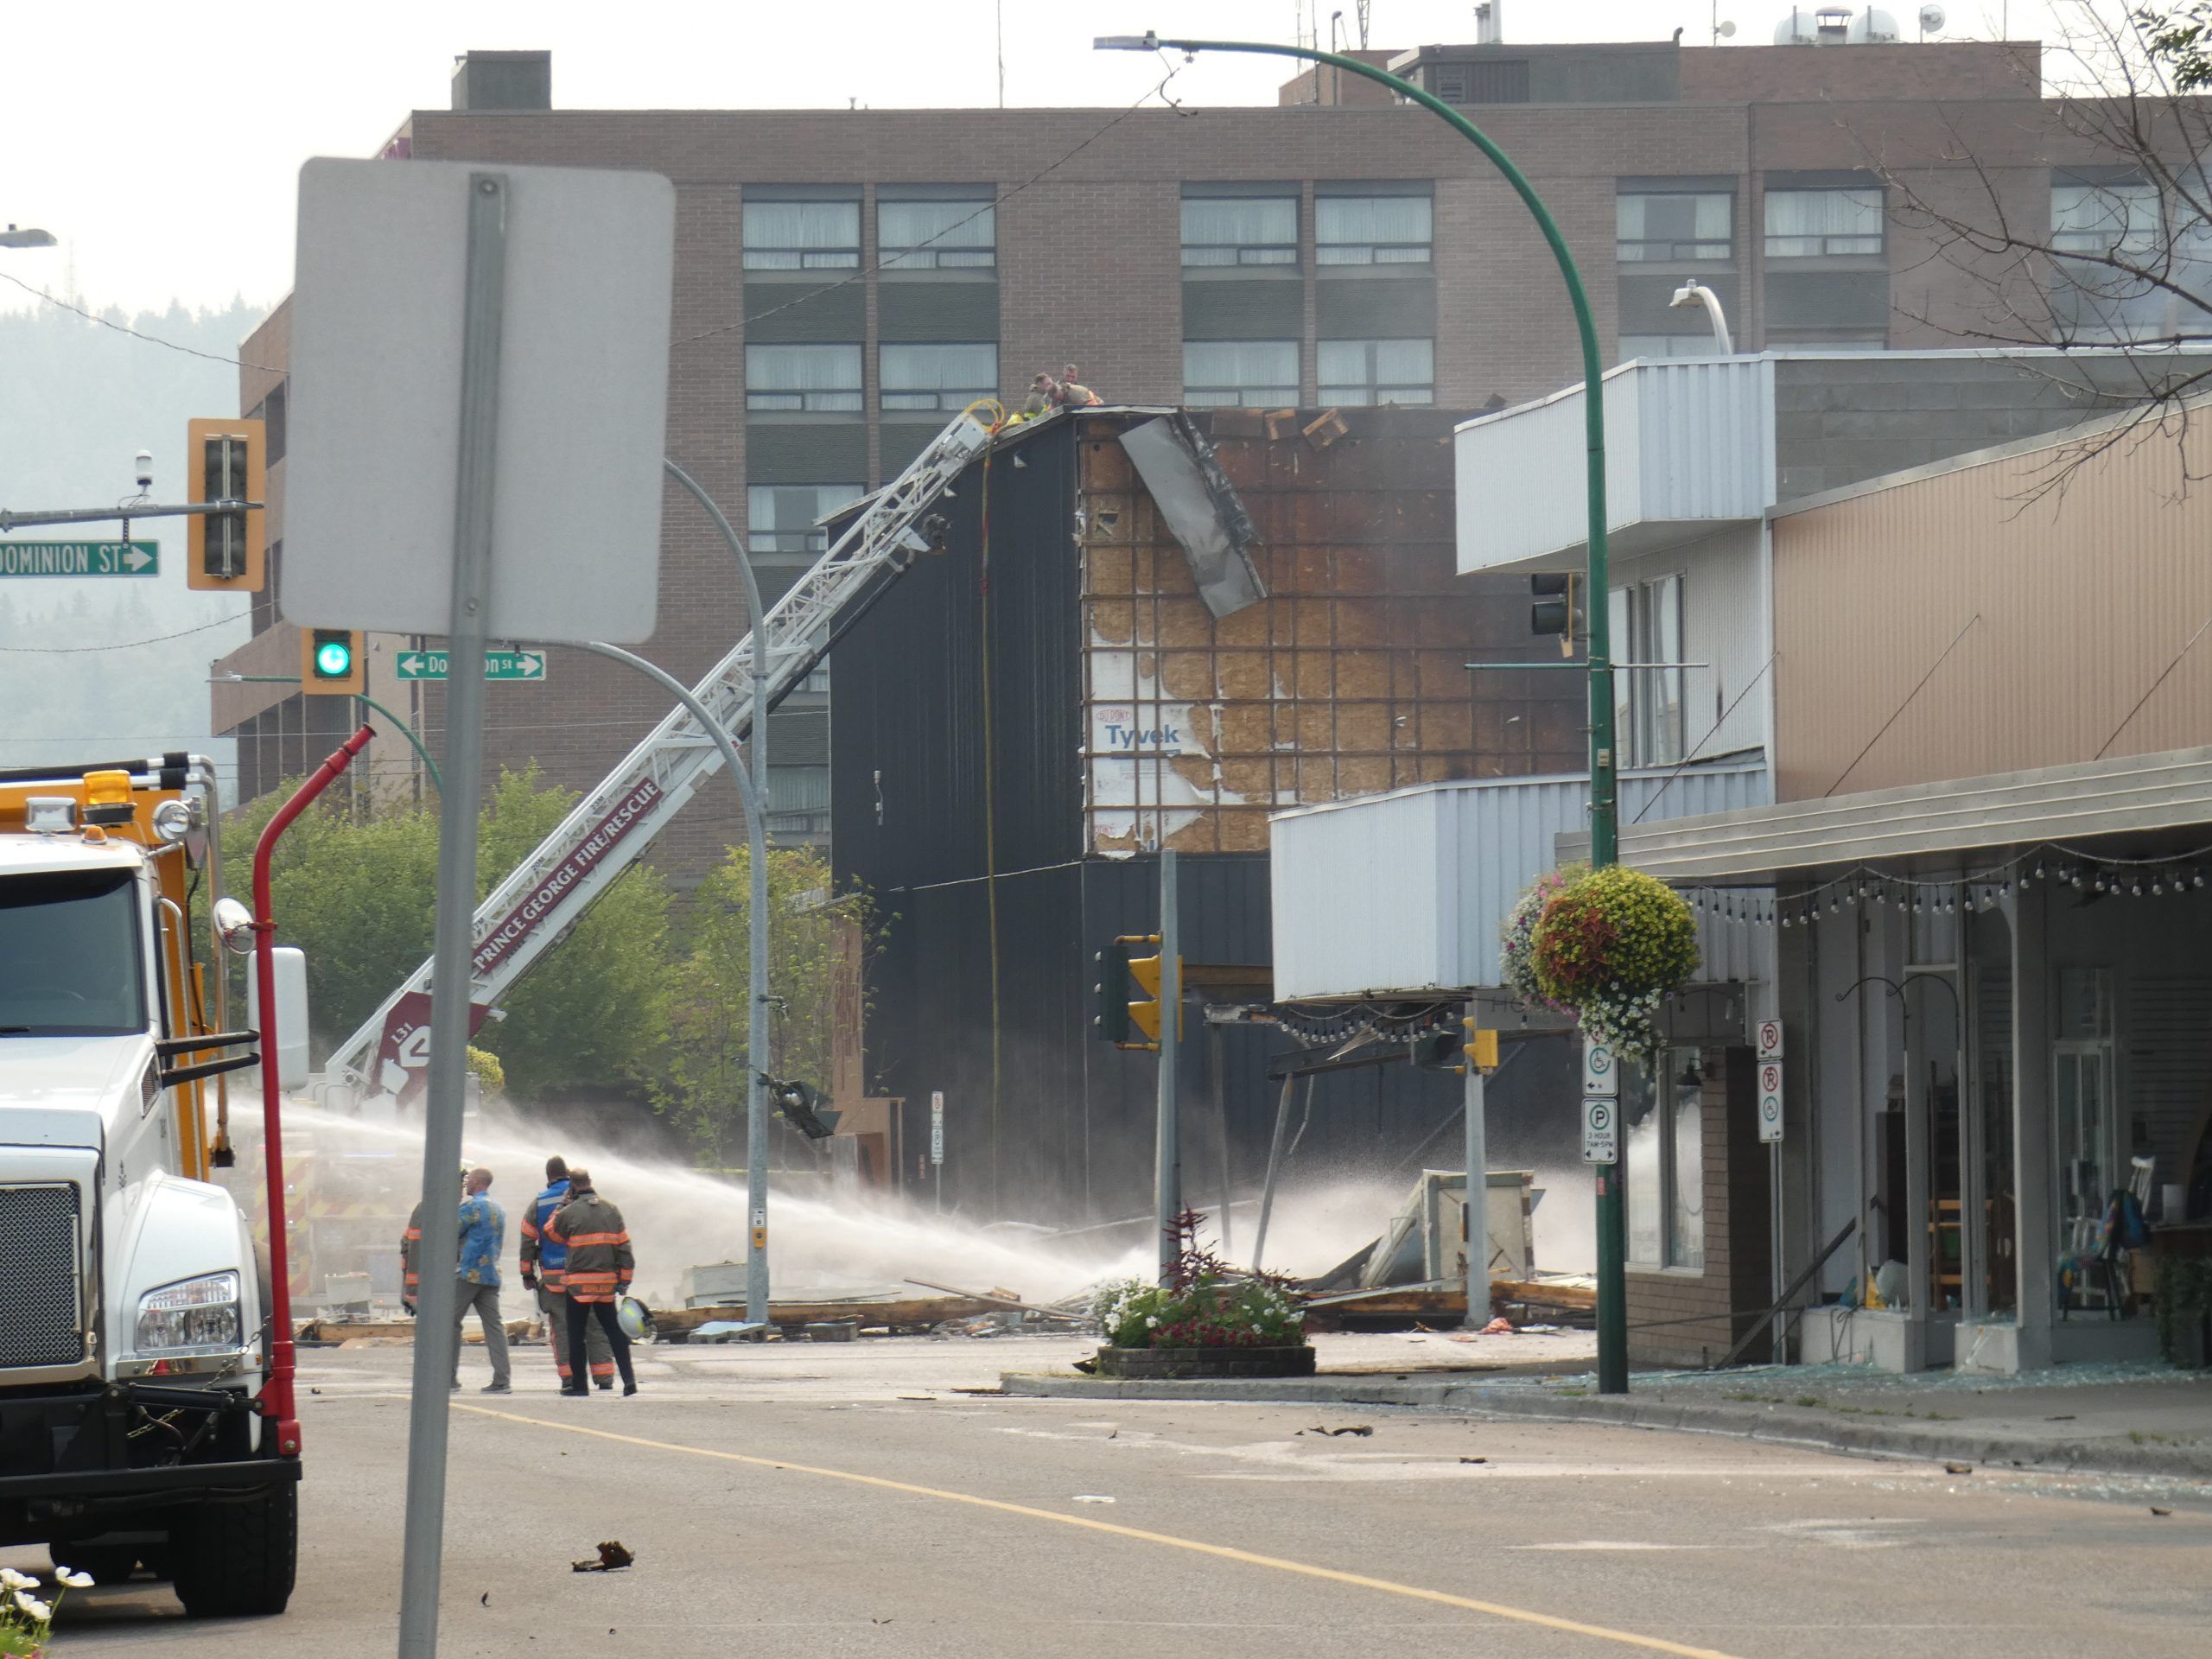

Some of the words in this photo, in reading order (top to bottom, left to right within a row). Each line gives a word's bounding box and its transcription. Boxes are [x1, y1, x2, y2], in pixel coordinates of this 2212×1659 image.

[0, 545, 88, 574] OMINION
[99, 545, 122, 573] ST
[1104, 724, 1180, 749] Tyvek
[473, 917, 527, 969] PRINCE
[522, 864, 579, 920] GEORGE
[574, 782, 658, 867] FIRE/RESCUE
[391, 1022, 414, 1044] L31
[1596, 1110, 1605, 1124] P
